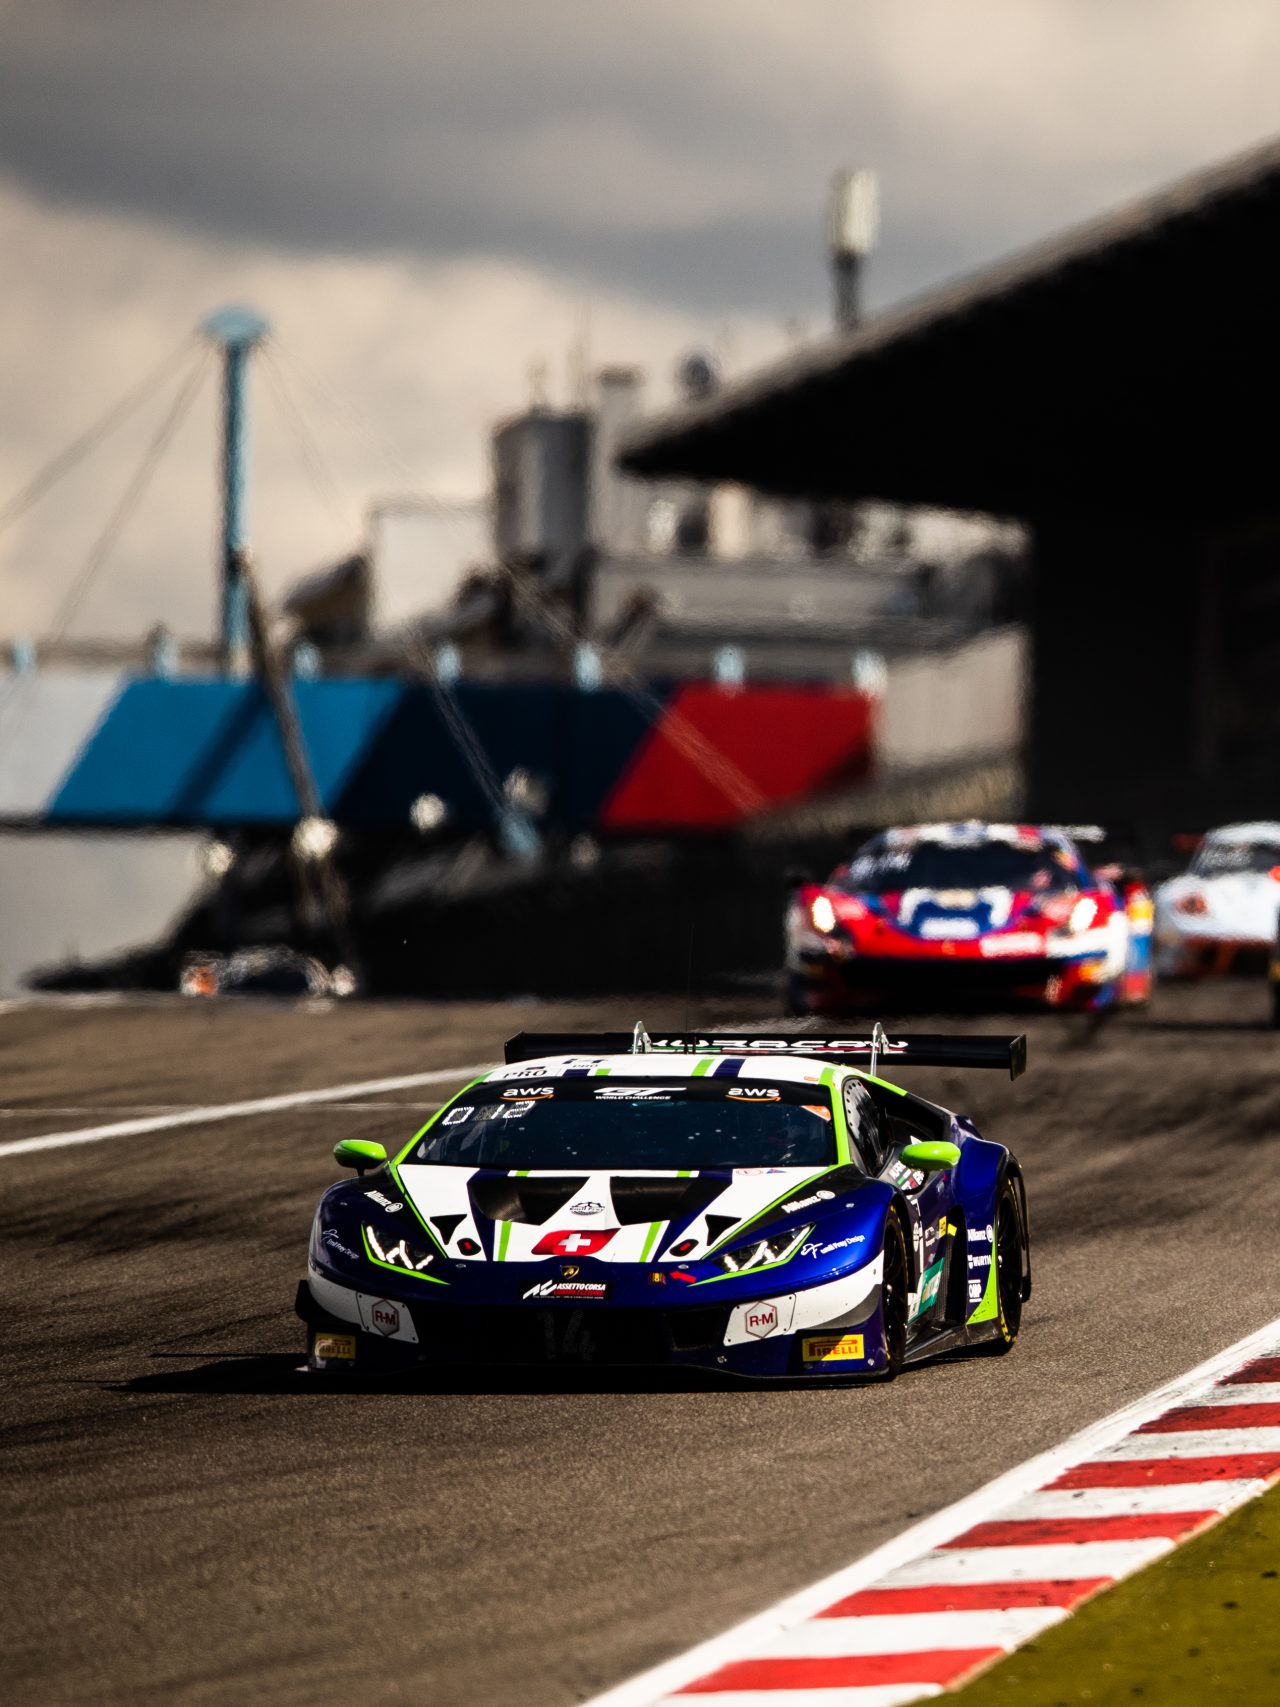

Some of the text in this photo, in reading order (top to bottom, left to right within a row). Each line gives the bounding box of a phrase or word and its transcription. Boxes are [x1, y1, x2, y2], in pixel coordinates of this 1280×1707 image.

[503, 1069, 548, 1078] PRO
[502, 1087, 555, 1098] aws
[593, 1086, 687, 1096] GT
[727, 1088, 781, 1098] aws
[585, 1283, 606, 1291] CORSA
[749, 1312, 774, 1328] R-M
[808, 1339, 858, 1357] PIRELLI
